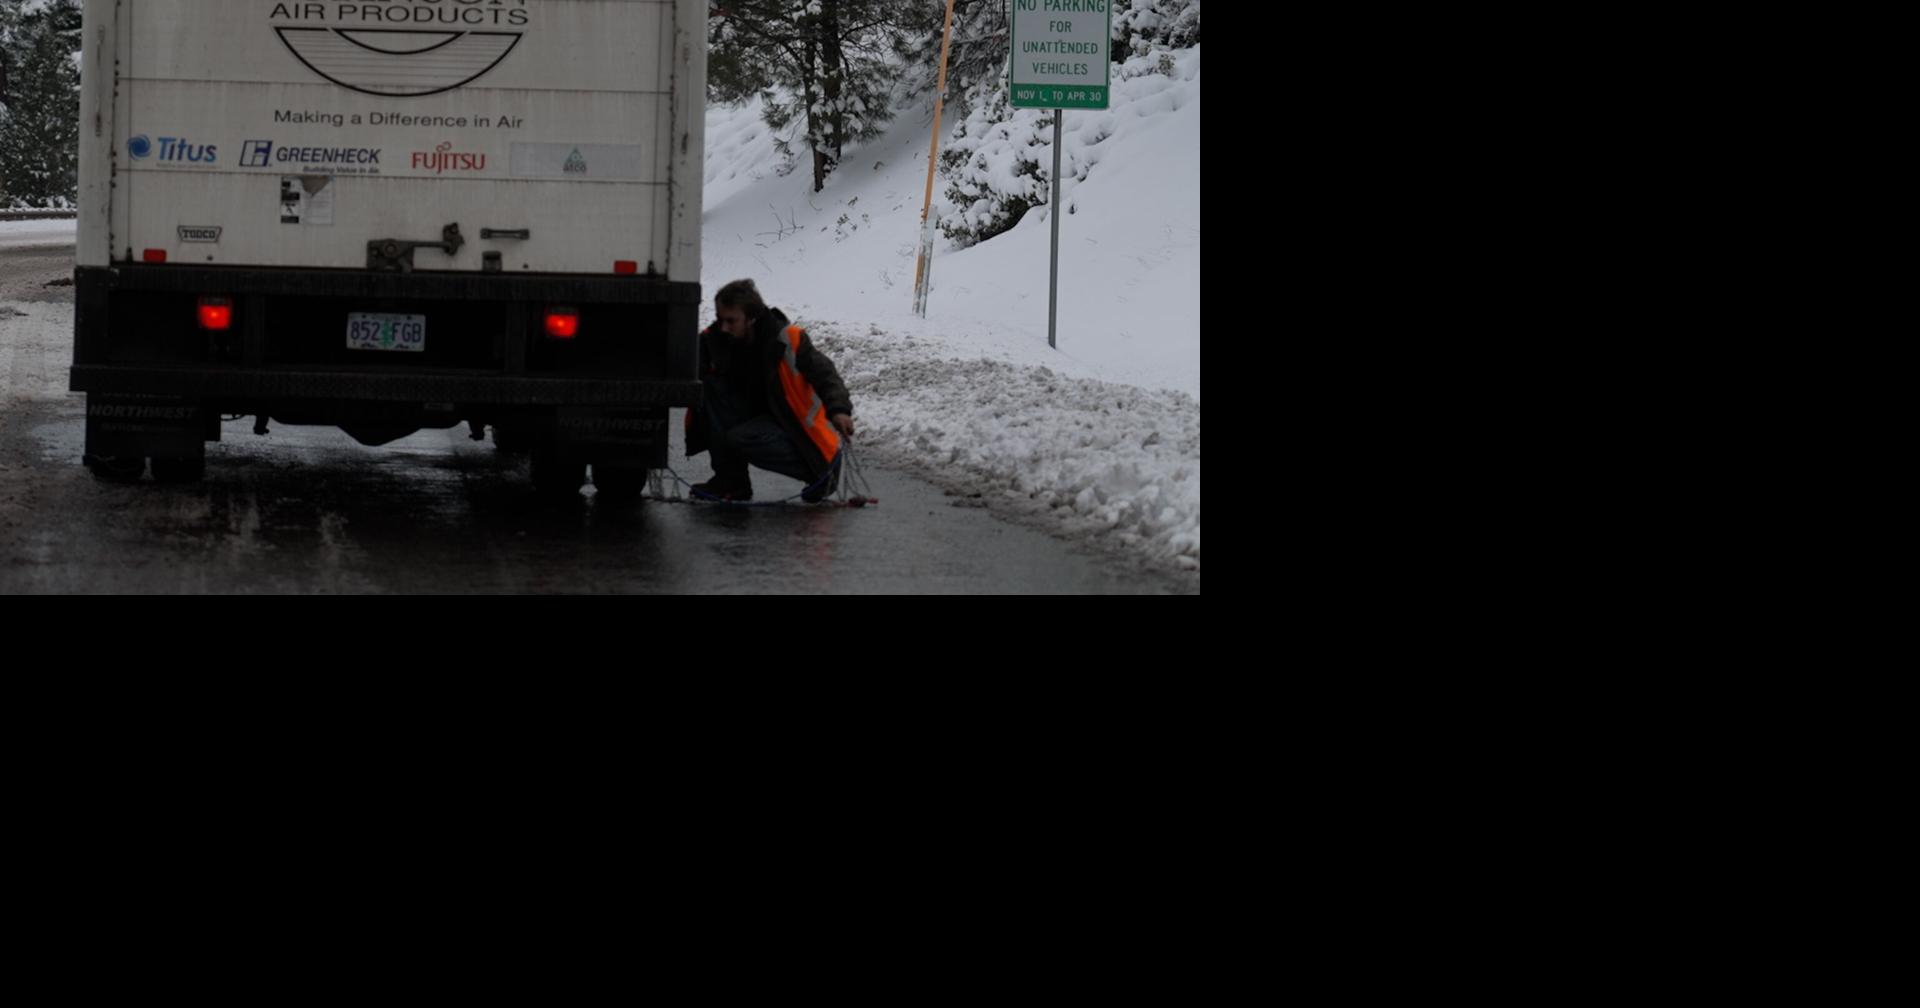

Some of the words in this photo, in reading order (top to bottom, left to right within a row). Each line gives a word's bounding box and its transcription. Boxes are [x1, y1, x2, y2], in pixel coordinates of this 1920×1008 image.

[270, 3, 325, 19] AIR
[338, 5, 529, 25] PRODUCTS
[1017, 0, 1036, 11] NO
[1044, 0, 1105, 13] PARKING
[1049, 20, 1072, 33] FOR
[1022, 41, 1098, 54] UNATTENDED
[1032, 62, 1088, 75] VEHICLES
[1017, 90, 1035, 100] NOV
[1052, 91, 1063, 100] TO
[1067, 91, 1085, 101] APR
[1089, 92, 1102, 101] 30
[274, 110, 343, 127] Making
[350, 114, 362, 124] a
[370, 112, 467, 127] Difference
[474, 115, 489, 127] in
[497, 115, 524, 128] Air
[158, 137, 217, 163] Titus
[276, 147, 381, 163] GREENHECK
[412, 151, 485, 174] FUJITSU
[351, 321, 380, 341] 852
[392, 322, 422, 342] FGB
[89, 404, 197, 420] NORTHWEST
[559, 415, 666, 432] NORTHWEST
